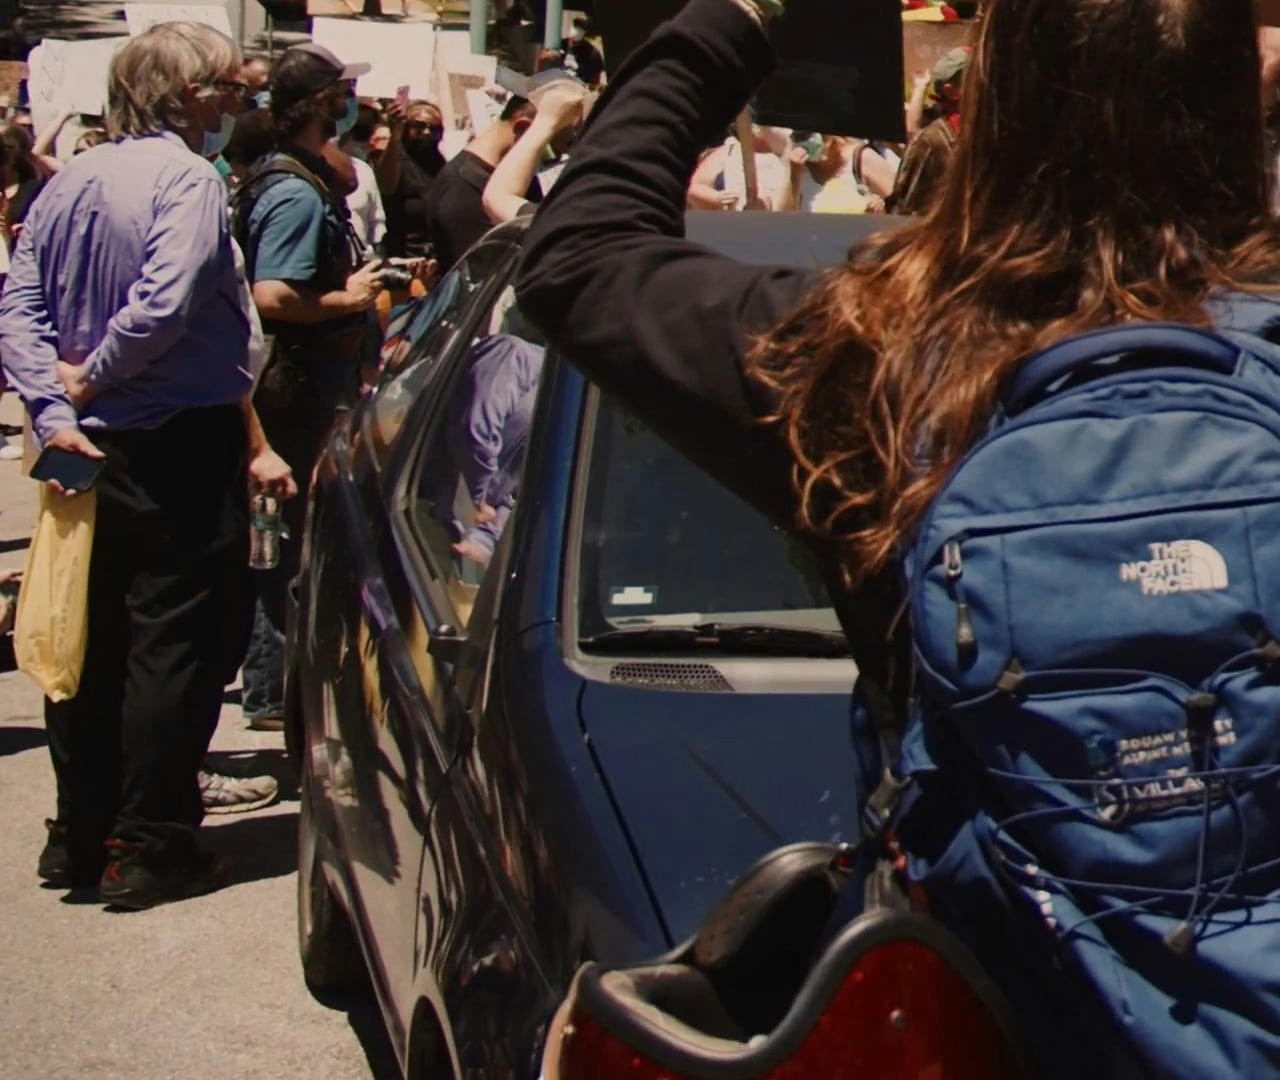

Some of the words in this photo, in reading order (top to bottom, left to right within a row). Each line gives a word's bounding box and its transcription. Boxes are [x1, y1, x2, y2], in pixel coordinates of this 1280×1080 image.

[1148, 542, 1191, 561] THE
[1120, 560, 1193, 582] NORTH
[1141, 576, 1194, 595] FACE
